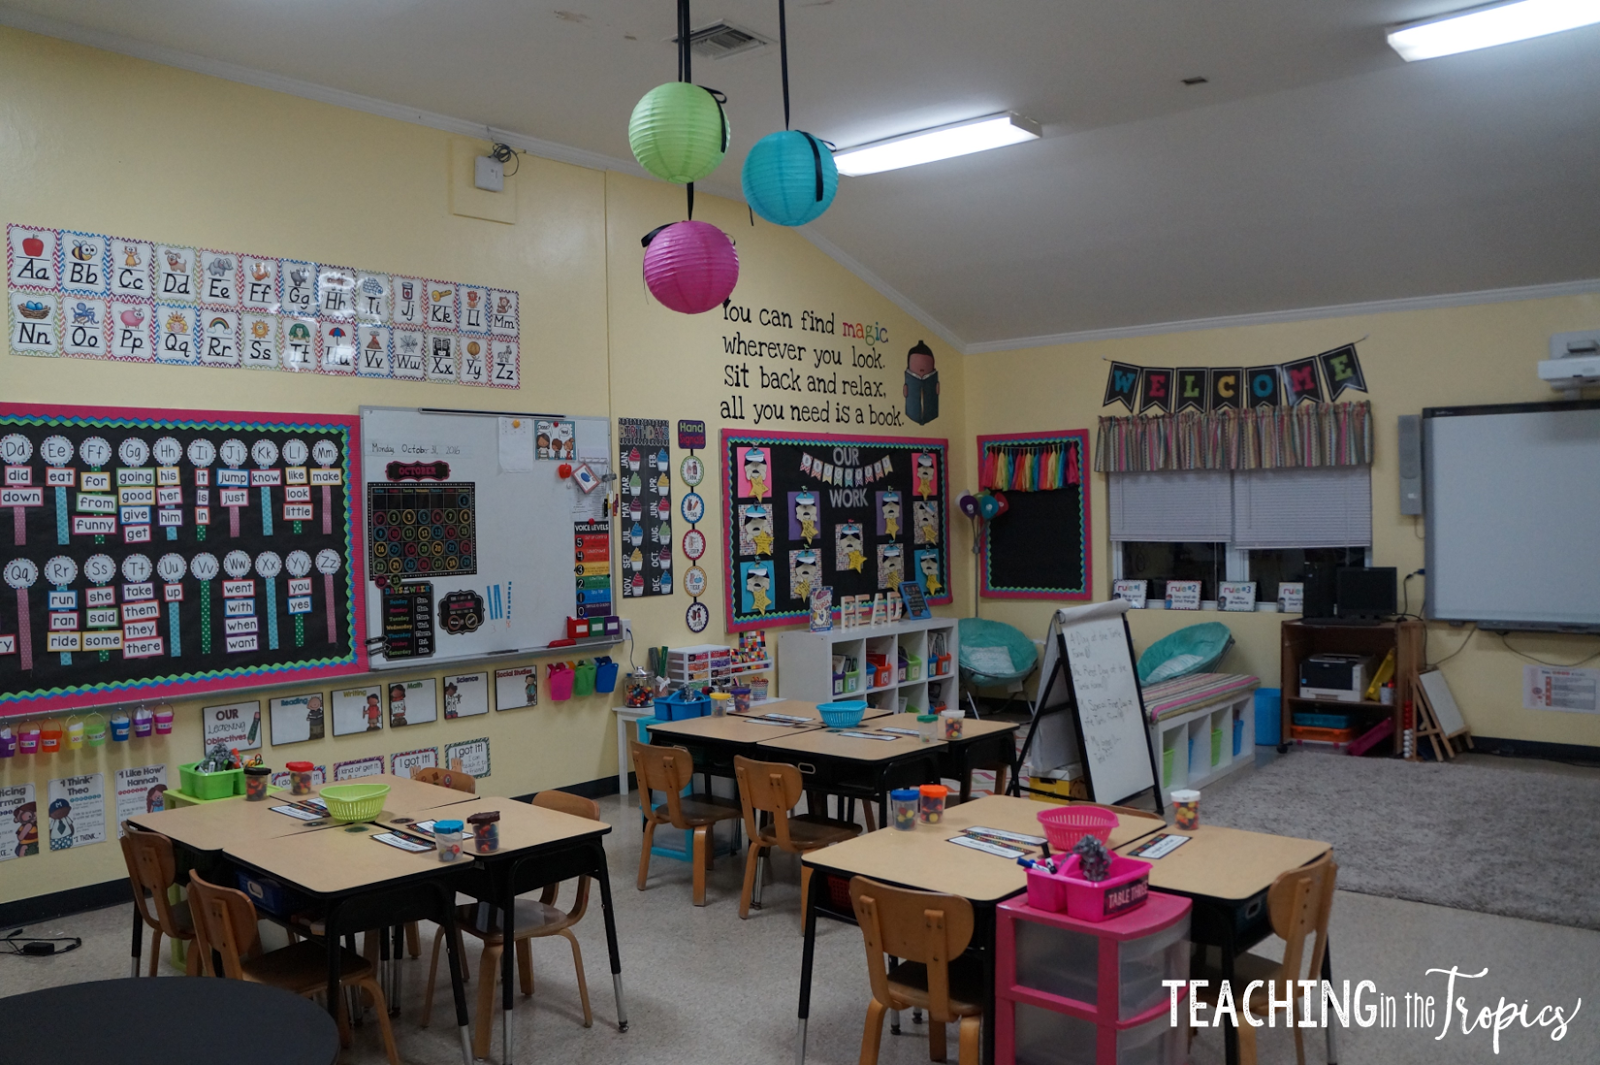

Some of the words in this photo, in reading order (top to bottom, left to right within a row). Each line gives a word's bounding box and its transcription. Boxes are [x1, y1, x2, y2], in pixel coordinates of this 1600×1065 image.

[18, 258, 50, 280] Aa
[70, 264, 98, 284] Bb
[119, 270, 143, 290] Cc
[164, 275, 189, 294] Dd
[209, 279, 230, 298] Ee
[250, 283, 272, 302] Ff
[289, 289, 310, 309] Gg
[402, 301, 415, 321] Jj
[432, 305, 452, 323] Kk
[494, 315, 515, 330] Mm
[759, 308, 793, 329] can
[801, 310, 834, 334] find
[842, 322, 888, 346] magic
[19, 323, 50, 344] Nn
[72, 327, 98, 347] Oo
[121, 330, 143, 353] Pp
[165, 333, 190, 358] Qq
[208, 338, 232, 356] Rr
[250, 341, 271, 360] Ss
[366, 351, 383, 368] Vv
[396, 355, 421, 370] Ww
[431, 357, 453, 375] Xx
[466, 360, 481, 380] Yy
[496, 364, 514, 380] Zz
[722, 332, 806, 362] wherever
[814, 348, 842, 368] you
[852, 346, 885, 369] look.
[724, 363, 749, 388] Sit
[760, 366, 801, 392] back
[807, 372, 836, 394] and
[842, 375, 886, 399] relax,
[1114, 354, 1354, 398] WELCOME
[720, 396, 744, 420] all
[753, 403, 784, 424] you
[790, 401, 829, 423] need
[835, 403, 850, 423] is
[855, 407, 864, 424] a
[869, 404, 904, 427] book.
[619, 425, 669, 440] BIRTHDAYS
[680, 422, 703, 432] Hand
[5, 442, 25, 457] Dd
[48, 443, 66, 457] Ee
[87, 445, 104, 459] Ff
[126, 444, 141, 461] Gg
[160, 444, 176, 457] Hh
[196, 446, 207, 460] Ii
[226, 446, 241, 462] Jj
[258, 447, 272, 460] Kk
[318, 447, 334, 458] Mm
[372, 443, 395, 455] Monday
[833, 447, 860, 466] OUR
[9, 470, 28, 481] did
[49, 471, 72, 482] eat
[160, 471, 176, 481] his
[288, 470, 304, 480] like
[313, 472, 340, 481] make
[398, 467, 436, 475] OCTOBER
[85, 476, 107, 486] for
[120, 472, 152, 484] going
[197, 472, 207, 482] it
[220, 473, 247, 484] jump
[252, 472, 280, 482] know
[2, 492, 40, 502] down
[122, 491, 152, 503] good
[160, 491, 179, 501] her
[198, 492, 207, 501] is
[224, 493, 245, 504] just
[287, 488, 308, 499] look
[829, 488, 868, 508] WORK
[80, 497, 114, 509] from
[124, 510, 148, 522] give
[161, 512, 182, 522] him
[198, 511, 207, 520] in
[286, 507, 310, 516] little
[76, 520, 114, 532] funny
[127, 528, 148, 541] get
[577, 538, 582, 547] 5
[11, 565, 30, 582] Qq
[54, 564, 69, 577] Rr
[92, 562, 107, 576] Ss
[129, 562, 146, 576] Tt
[164, 561, 179, 574] Uu
[198, 560, 214, 574] Vv
[229, 558, 246, 570] Ww
[262, 558, 276, 571] Xx
[291, 558, 306, 572] Yy
[321, 556, 337, 569] Zz
[577, 565, 583, 574] 3
[225, 583, 252, 593] went
[291, 582, 310, 592] you
[578, 580, 584, 589] 2
[89, 591, 112, 602] she
[126, 586, 151, 597] take
[167, 588, 180, 598] up
[52, 595, 74, 605] run
[290, 600, 309, 610] yes
[125, 605, 157, 617] them
[228, 602, 252, 612] with
[841, 592, 902, 630] READ
[53, 617, 75, 626] ran
[89, 612, 115, 622] said
[127, 624, 154, 637] they
[227, 620, 257, 631] when
[51, 636, 78, 646] ride
[85, 636, 120, 646] some
[228, 638, 256, 649] want
[126, 641, 160, 653] there
[496, 670, 513, 678] Social
[514, 668, 532, 677] Studies
[456, 675, 478, 684] Science
[407, 681, 423, 690] Math
[343, 689, 367, 698] Writing
[280, 698, 308, 707] Reading
[216, 708, 239, 721] OUR
[206, 734, 247, 746] Objectives
[459, 746, 473, 758] got
[404, 756, 420, 769] got
[127, 776, 158, 787] Hannah
[67, 786, 89, 796] Theo
[1108, 884, 1130, 908] TABLE
